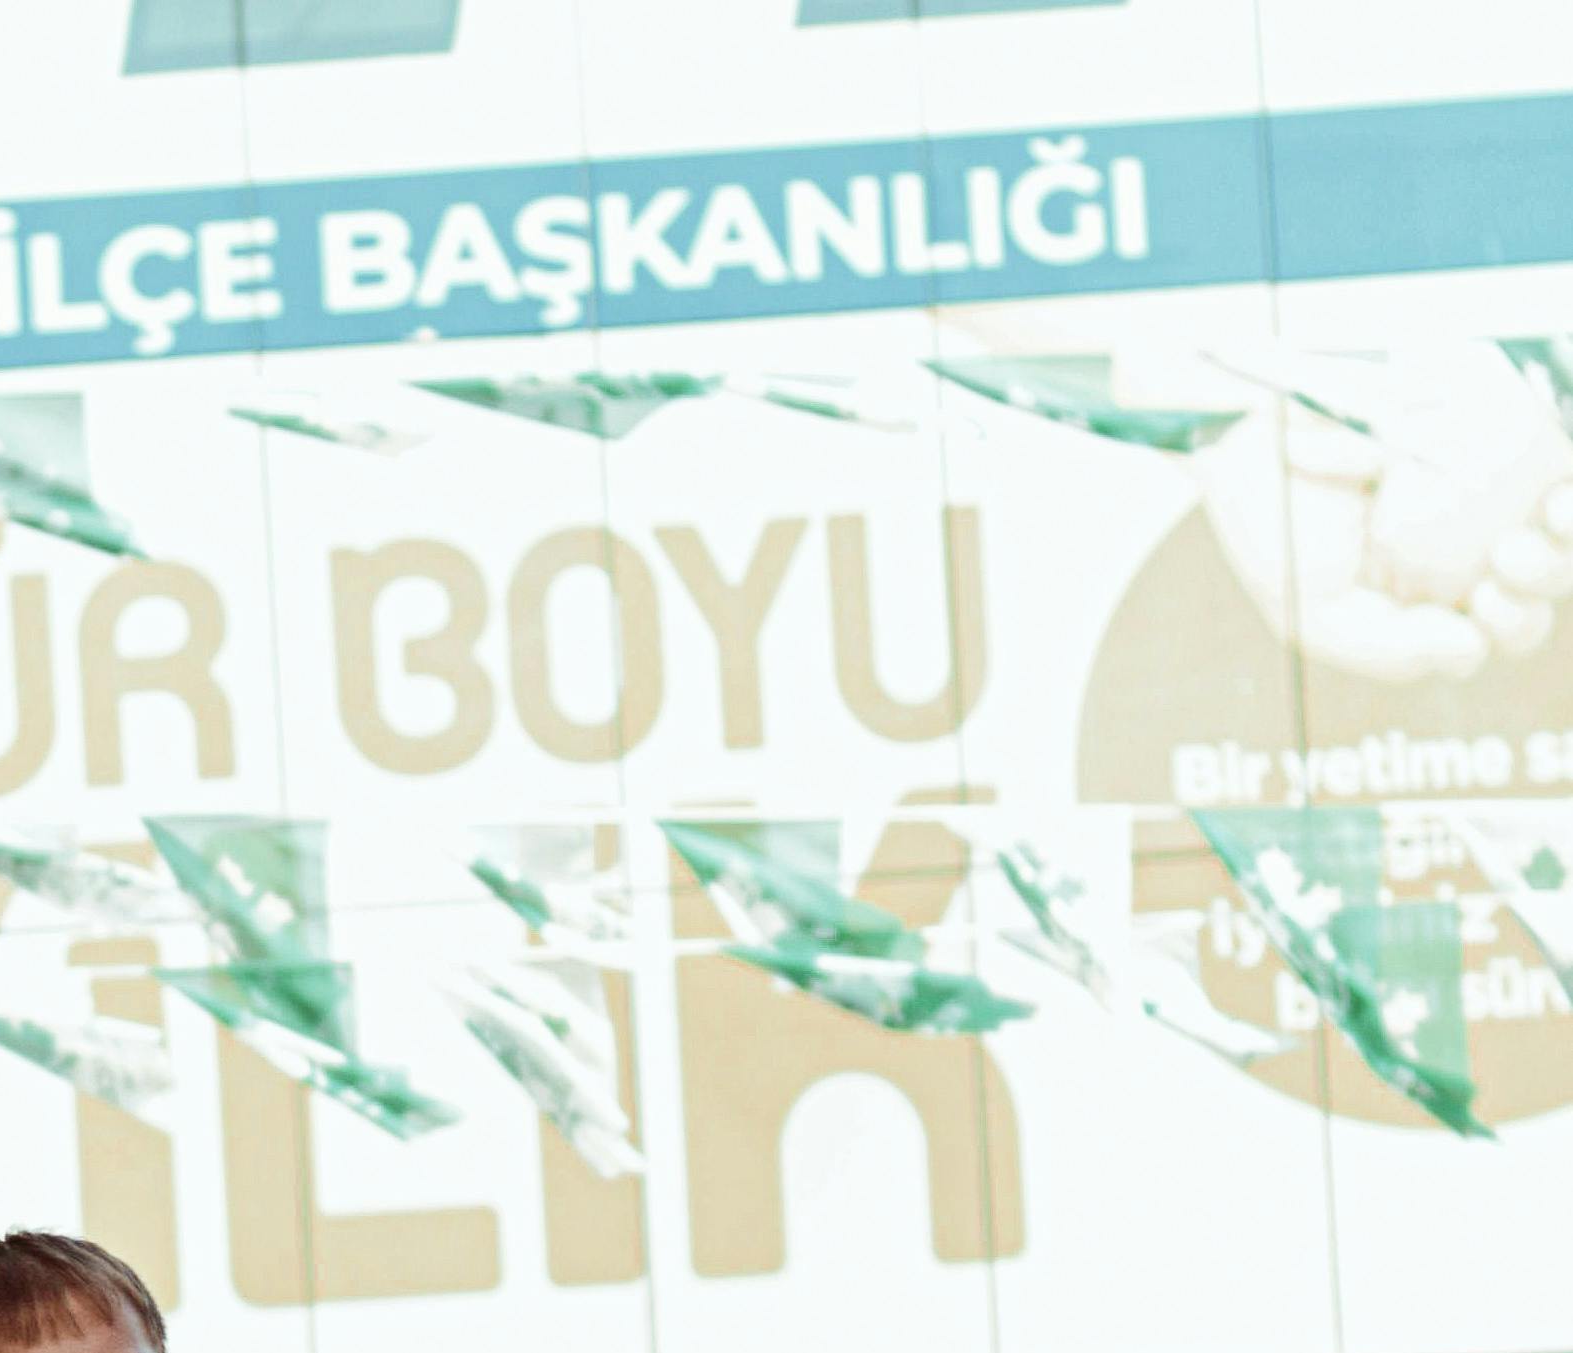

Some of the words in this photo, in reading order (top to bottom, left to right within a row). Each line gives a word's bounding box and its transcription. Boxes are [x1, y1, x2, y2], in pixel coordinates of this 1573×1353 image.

[318, 135, 1150, 329] BAŞKANLIĞI
[328, 504, 990, 776] BOYU
[1172, 740, 1272, 804] Bir
[1278, 729, 1513, 808] yetime
